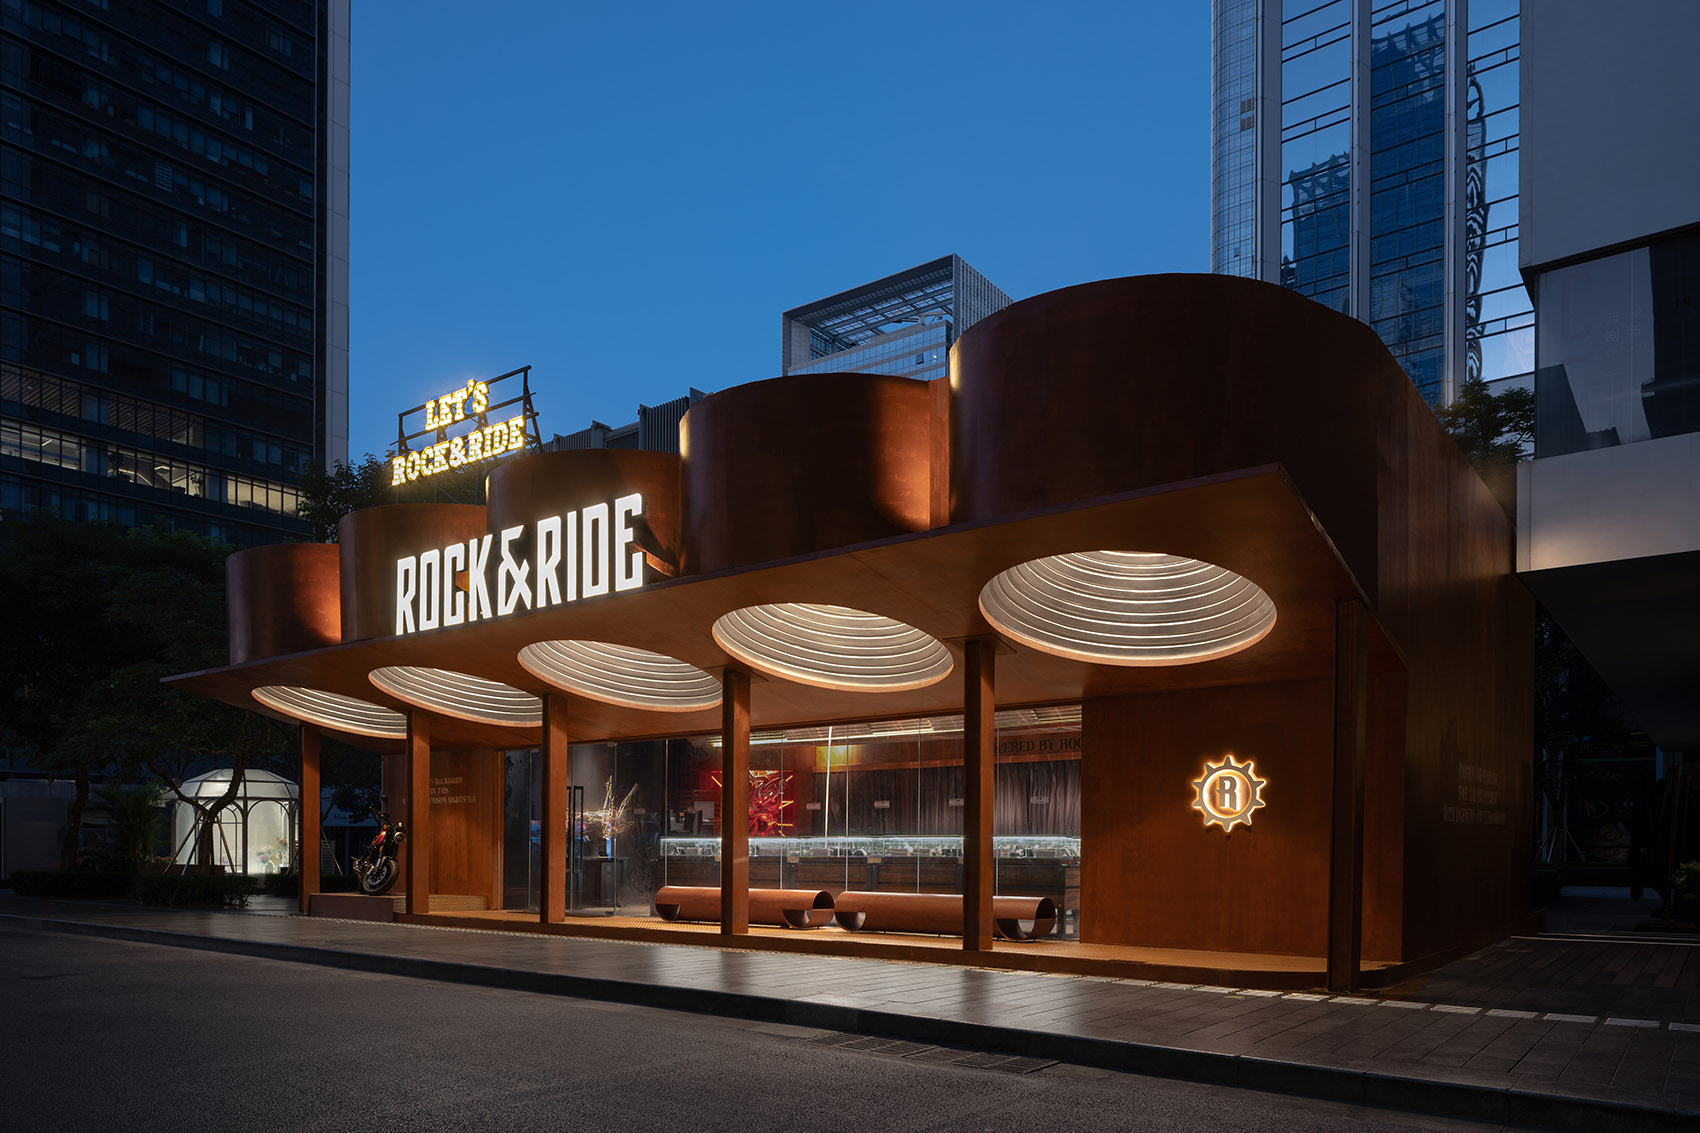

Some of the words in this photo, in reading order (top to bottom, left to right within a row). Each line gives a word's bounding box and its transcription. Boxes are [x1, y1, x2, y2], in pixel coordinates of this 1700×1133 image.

[425, 379, 489, 431] LET'S
[391, 415, 524, 486] ROCK&RIDE
[396, 493, 643, 636] ROCK&RIDE
[1039, 739, 1054, 751] BY
[1216, 775, 1239, 812] R
